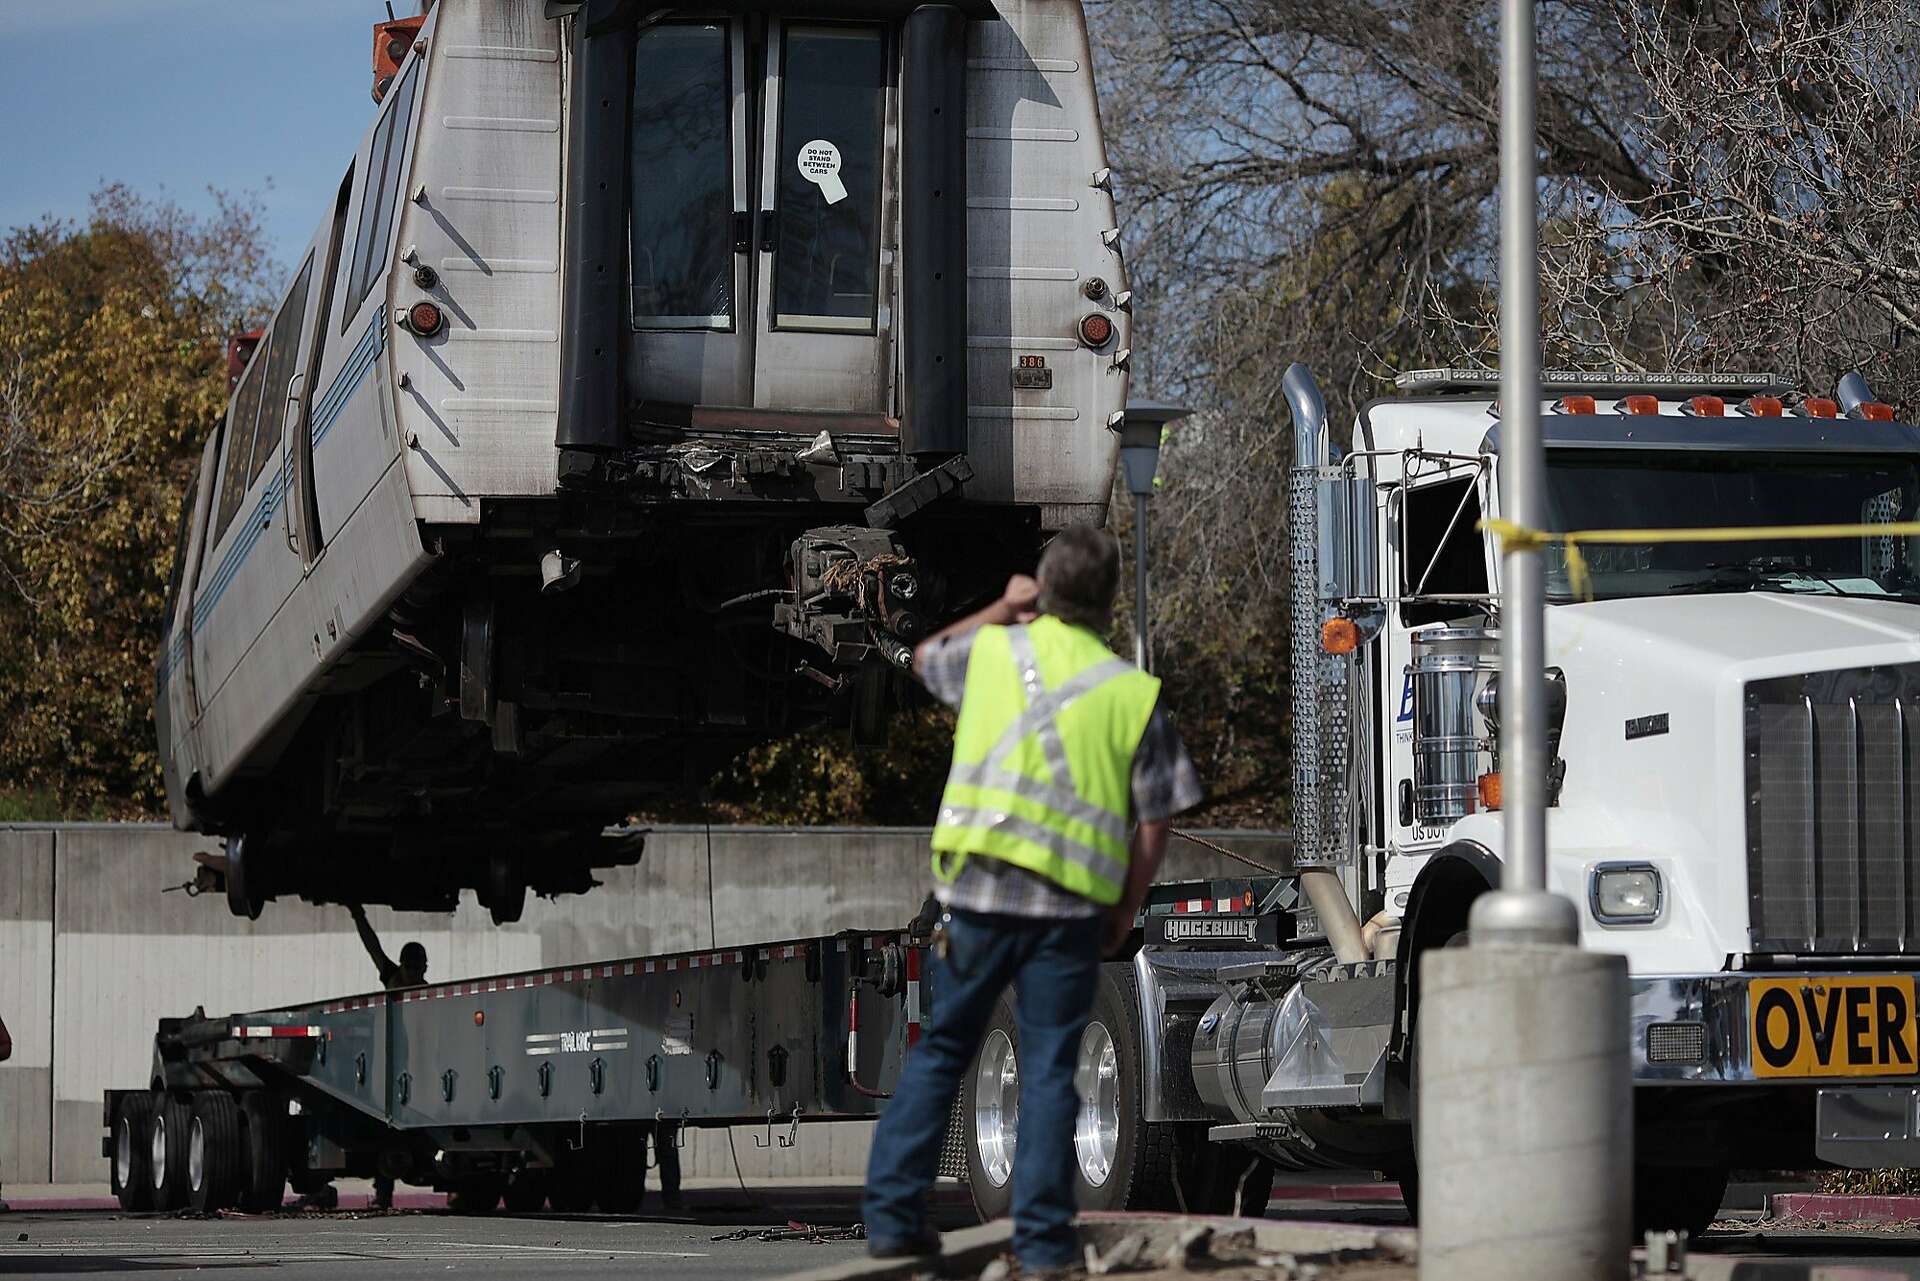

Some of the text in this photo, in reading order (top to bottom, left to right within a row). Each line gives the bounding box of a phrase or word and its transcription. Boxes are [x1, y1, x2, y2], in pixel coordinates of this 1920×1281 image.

[803, 161, 836, 169] BETWEEN
[1020, 356, 1044, 368] 386
[1411, 825, 1425, 841] US
[1165, 919, 1258, 941] HOGEBUILT
[1756, 986, 1913, 1068] OVER
